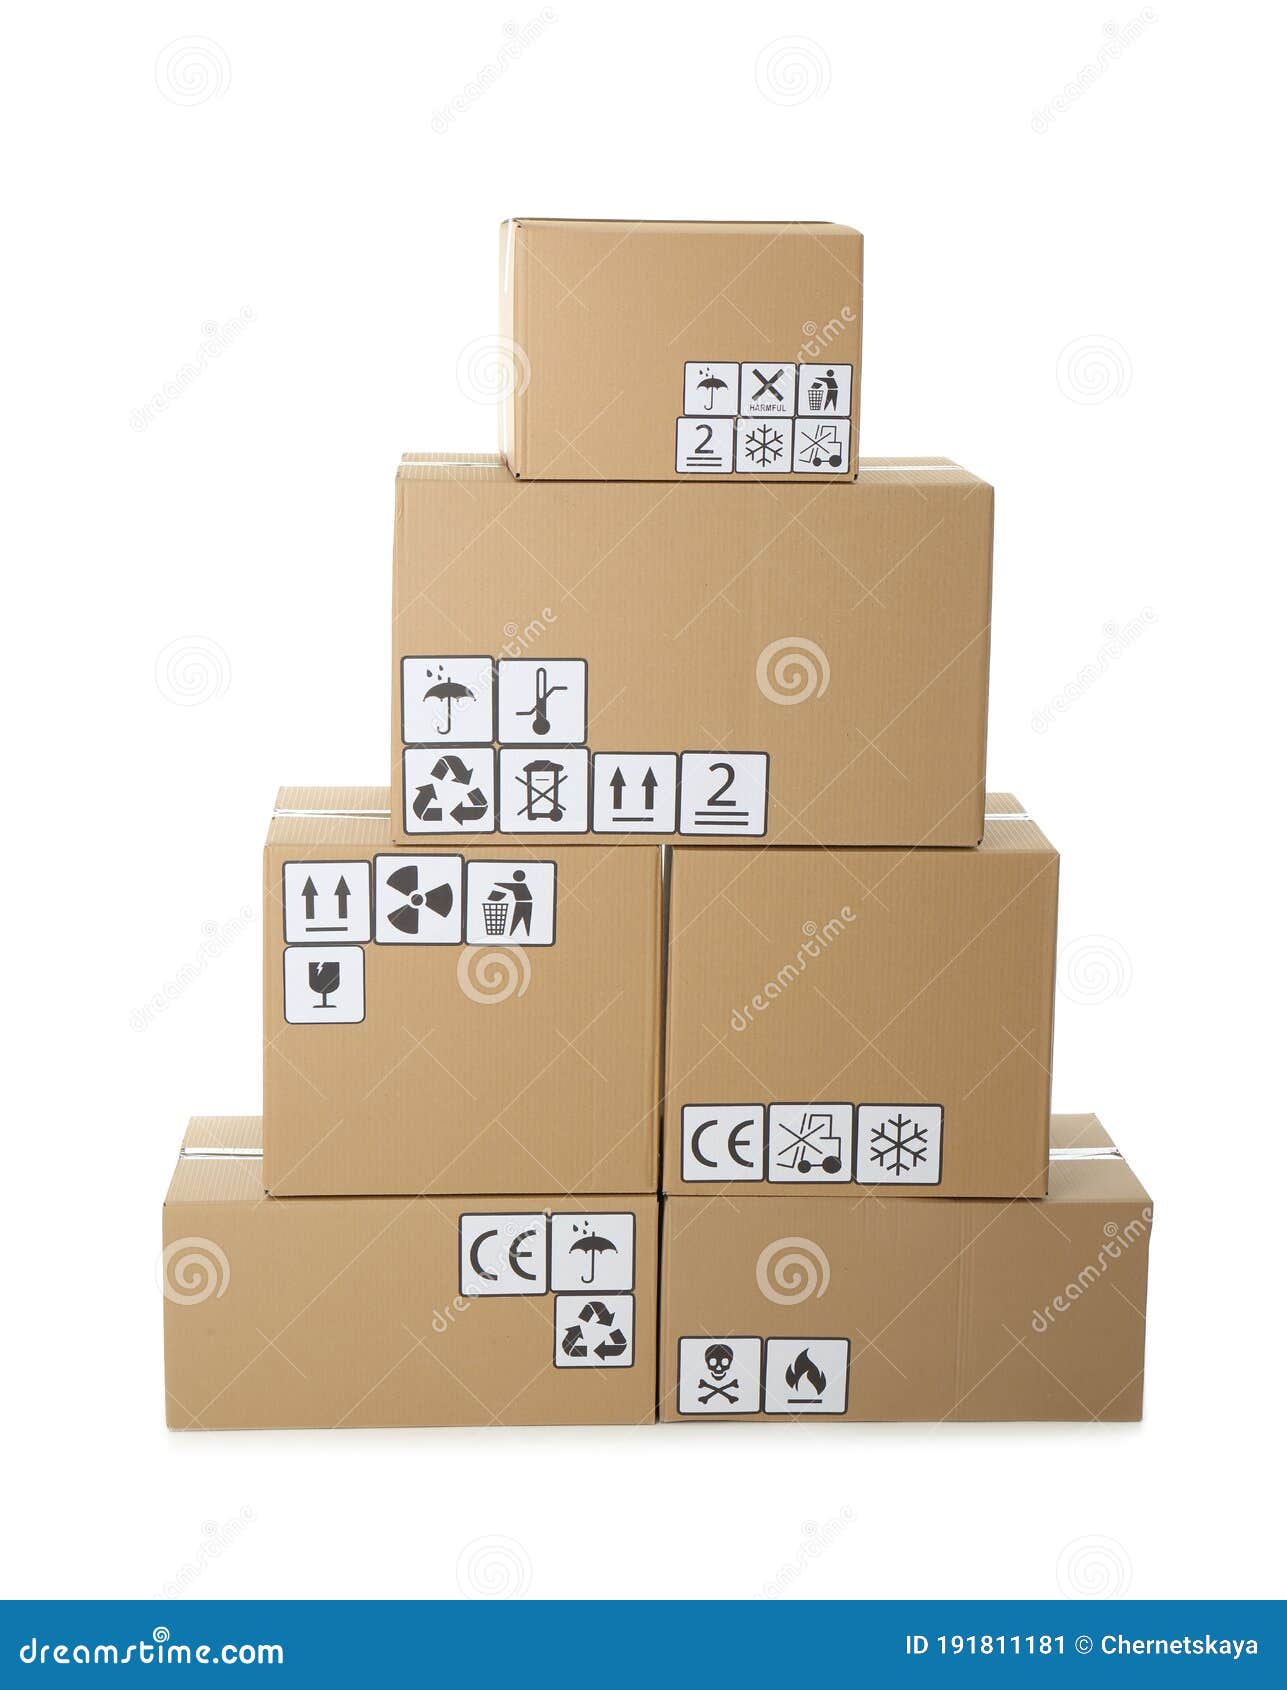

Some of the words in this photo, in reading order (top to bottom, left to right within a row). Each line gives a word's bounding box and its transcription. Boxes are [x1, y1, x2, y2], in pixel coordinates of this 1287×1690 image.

[749, 404, 787, 412] HARMFUL
[694, 424, 714, 454] 2
[707, 762, 737, 807] 2
